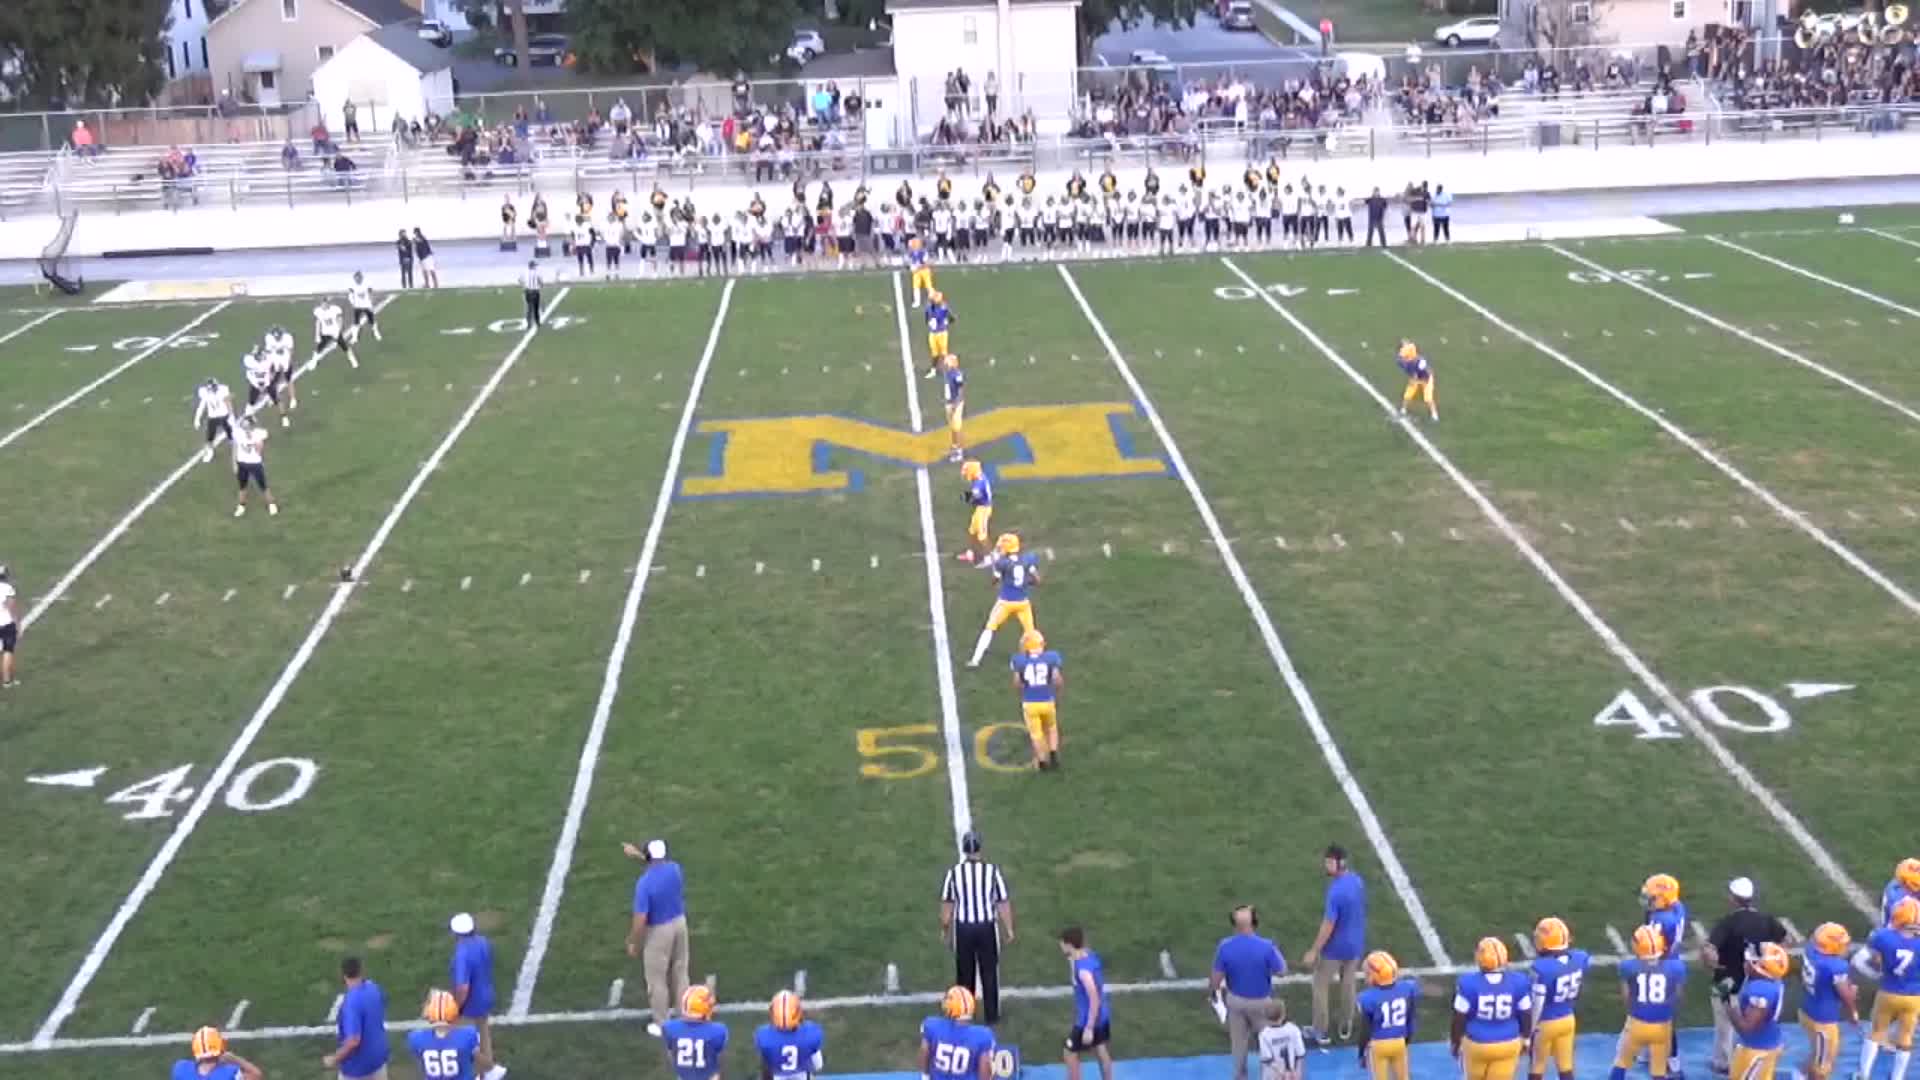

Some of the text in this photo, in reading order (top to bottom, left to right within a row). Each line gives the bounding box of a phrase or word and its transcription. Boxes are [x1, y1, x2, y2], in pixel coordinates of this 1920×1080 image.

[680, 402, 1168, 500] M
[1024, 662, 1049, 686] 42
[1593, 685, 1791, 738] 40
[857, 722, 1040, 778] 50
[104, 756, 319, 819] 40
[1893, 948, 1914, 976] 7
[1553, 970, 1583, 1003] 55
[1636, 972, 1667, 1004] 18
[1381, 997, 1407, 1029] 12
[1477, 994, 1513, 1020] 56
[422, 1049, 460, 1076] 66
[677, 1037, 705, 1068] 21
[781, 1045, 798, 1071] 3
[935, 1042, 970, 1074] 50
